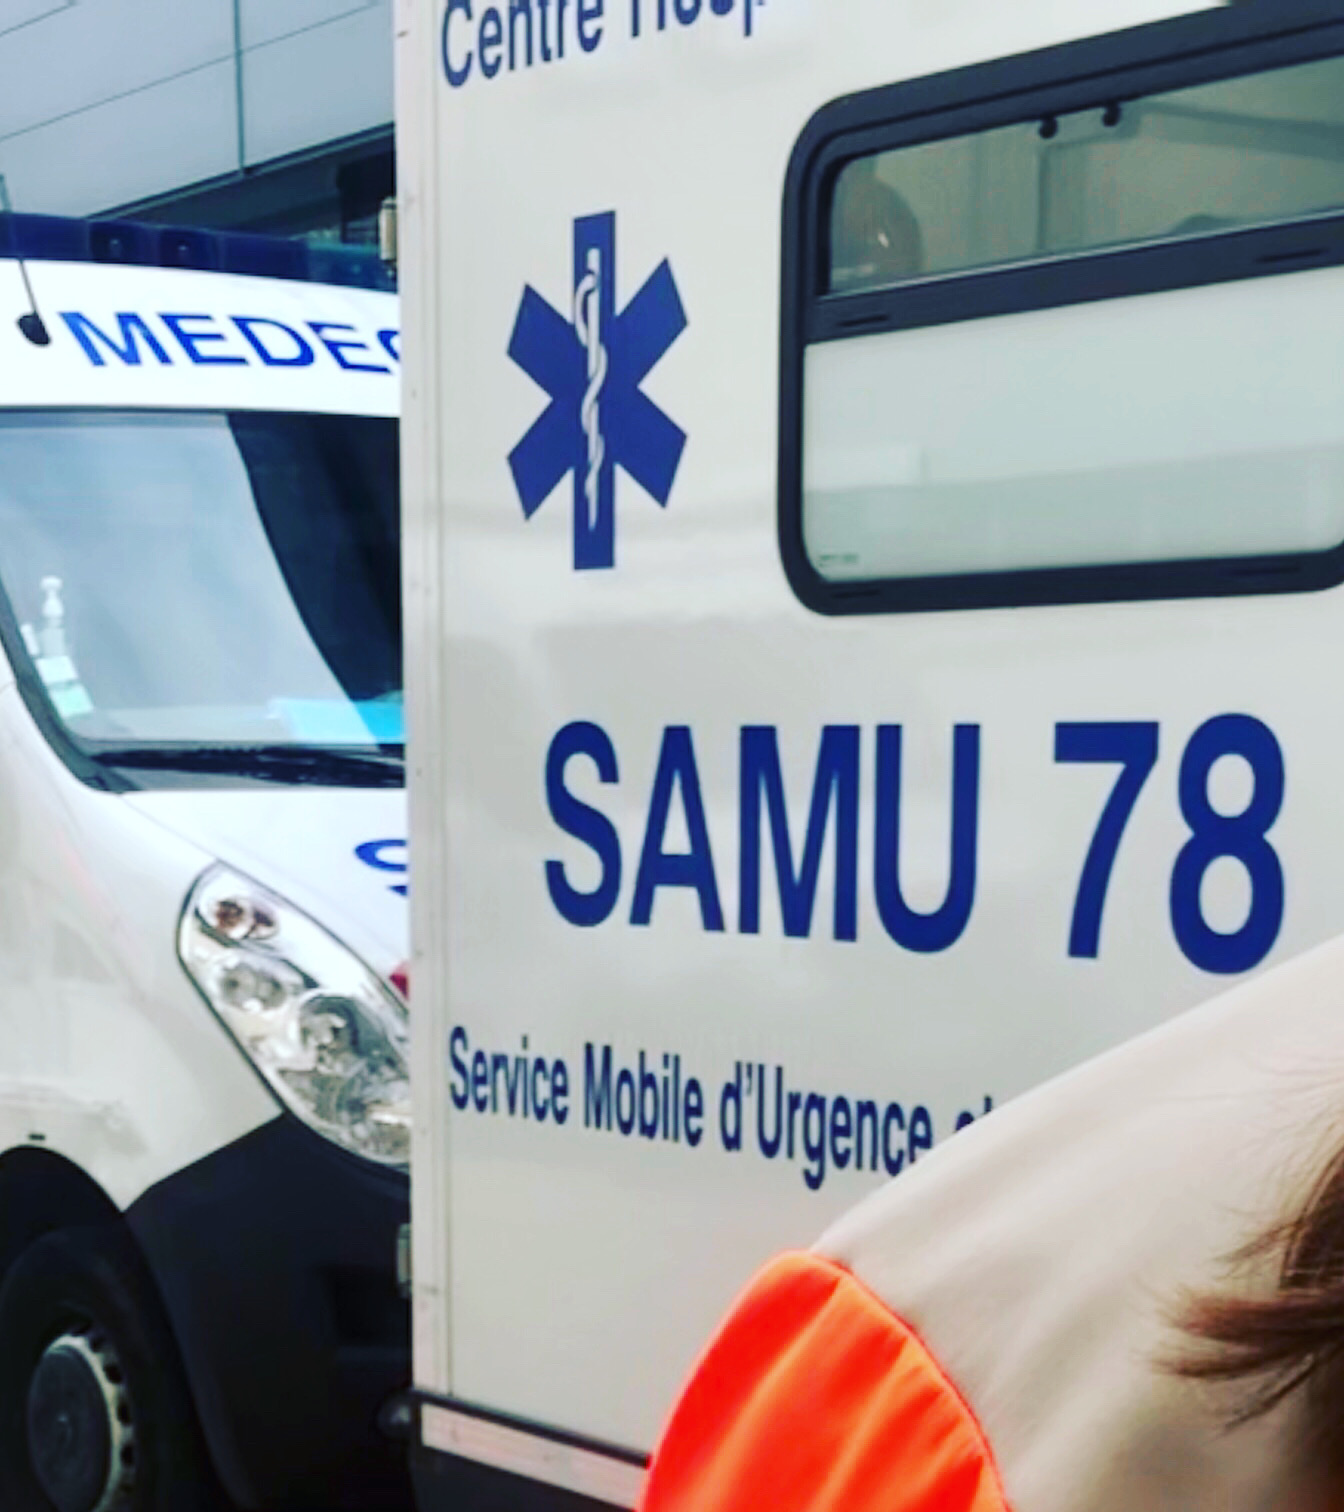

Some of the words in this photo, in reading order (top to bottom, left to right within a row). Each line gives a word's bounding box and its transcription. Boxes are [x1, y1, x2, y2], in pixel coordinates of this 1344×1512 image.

[442, 0, 604, 88] Centre
[544, 720, 981, 953] SAMU
[1054, 713, 1285, 975] 78
[449, 1025, 569, 1125] Service
[583, 1041, 705, 1147] Mobile
[719, 1060, 934, 1190] d'Urgence
